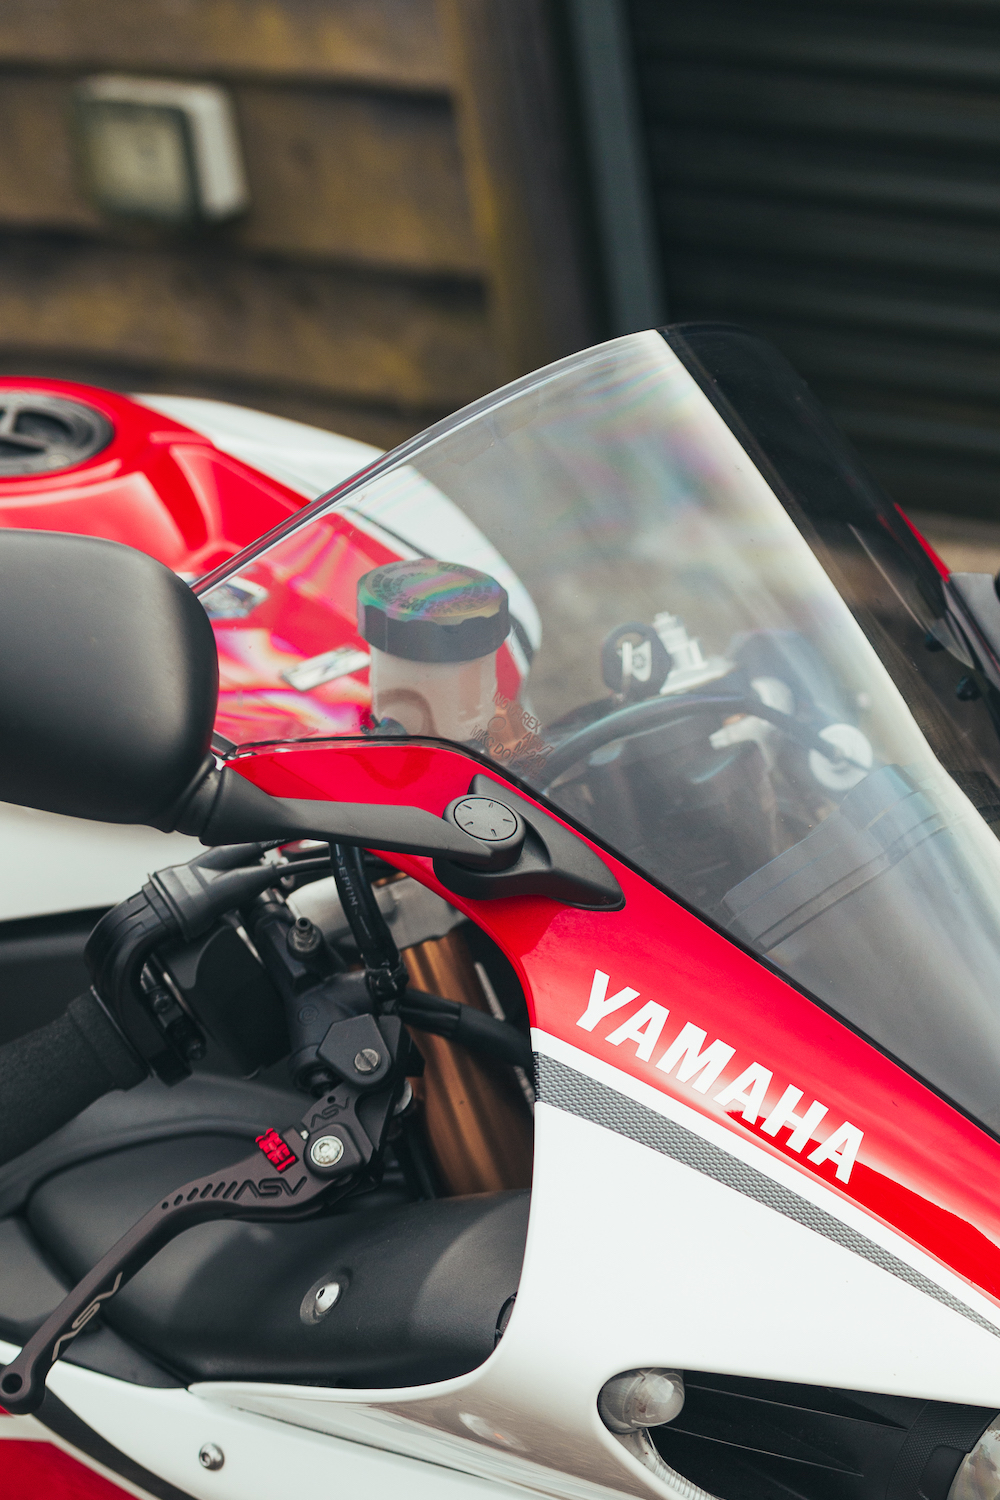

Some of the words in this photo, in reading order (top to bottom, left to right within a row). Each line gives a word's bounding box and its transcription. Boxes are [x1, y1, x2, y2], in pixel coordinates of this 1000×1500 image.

[492, 691, 541, 733] NOVAREX
[576, 969, 865, 1185] YAMAHA
[233, 1176, 307, 1200] ASV
